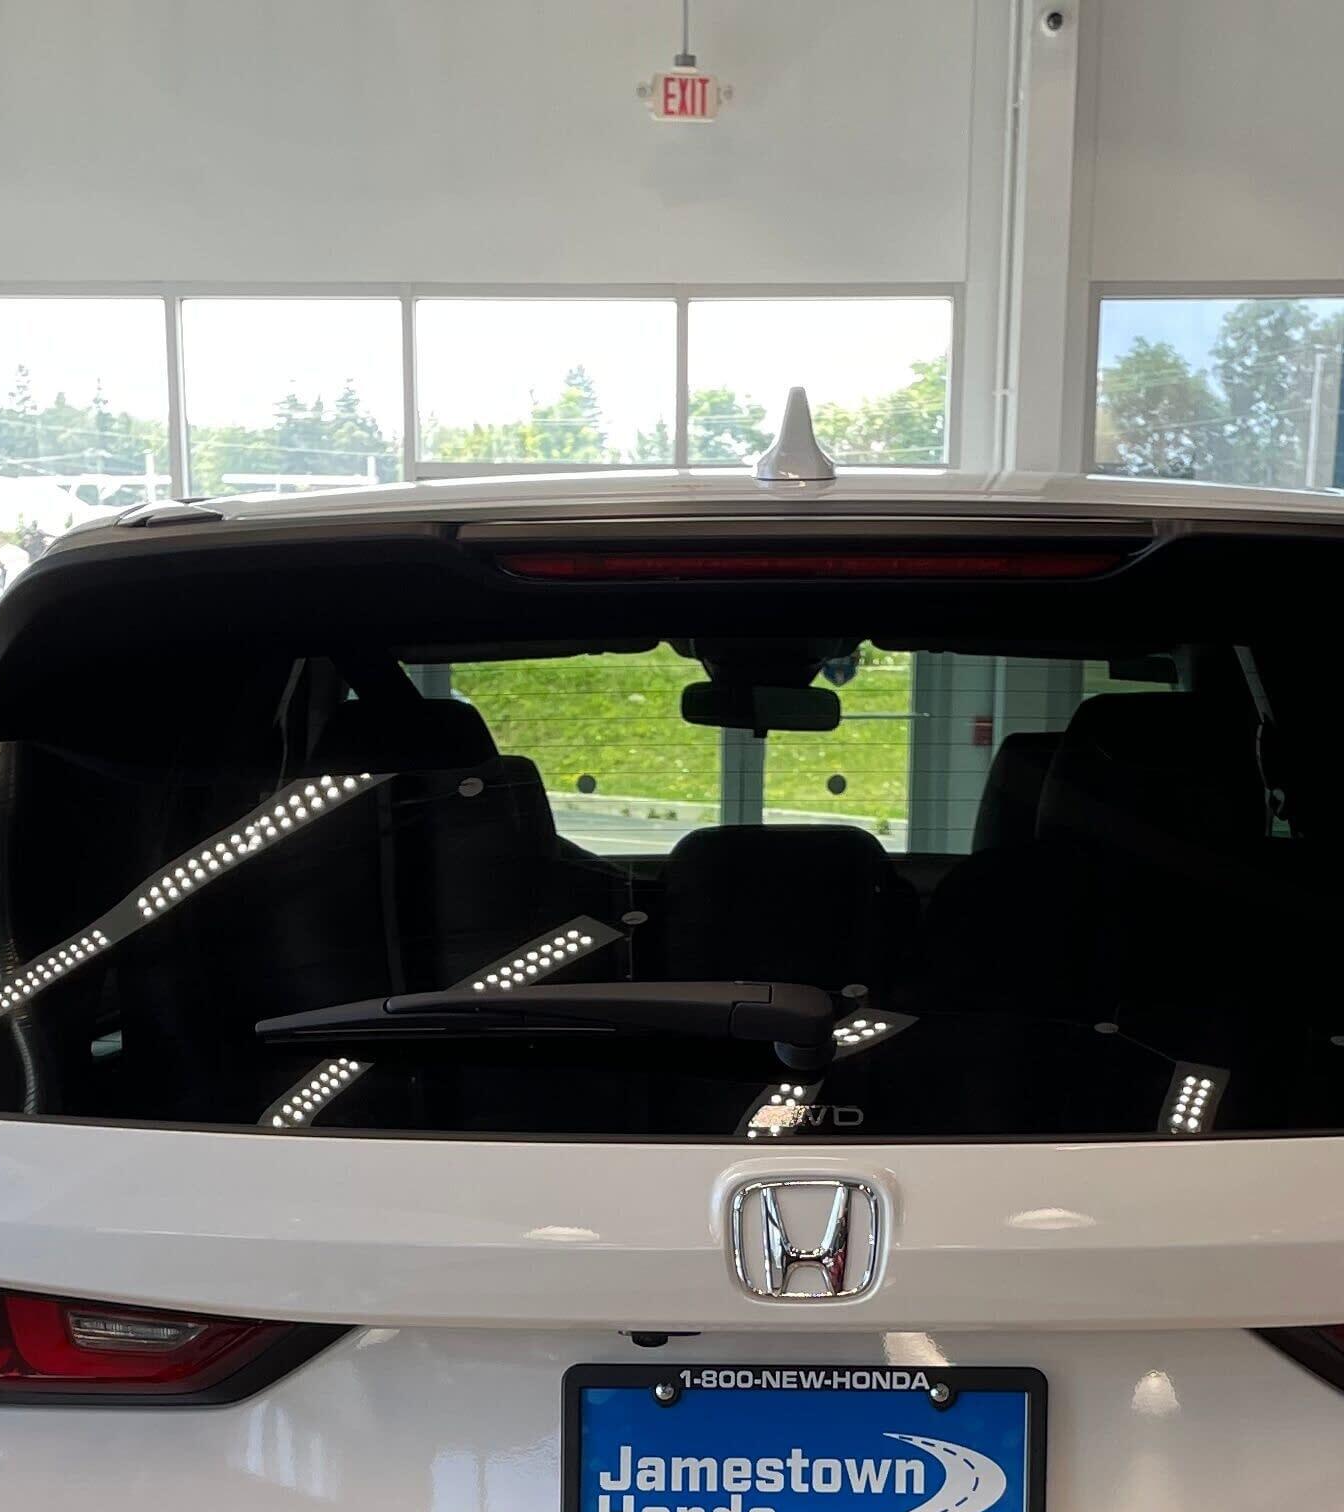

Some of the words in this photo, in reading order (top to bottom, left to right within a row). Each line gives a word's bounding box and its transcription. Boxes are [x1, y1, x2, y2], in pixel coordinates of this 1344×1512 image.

[663, 77, 710, 115] EXIT
[679, 1369, 930, 1391] 1-800-NEW-HONDA
[599, 1446, 925, 1495] Jamestown
